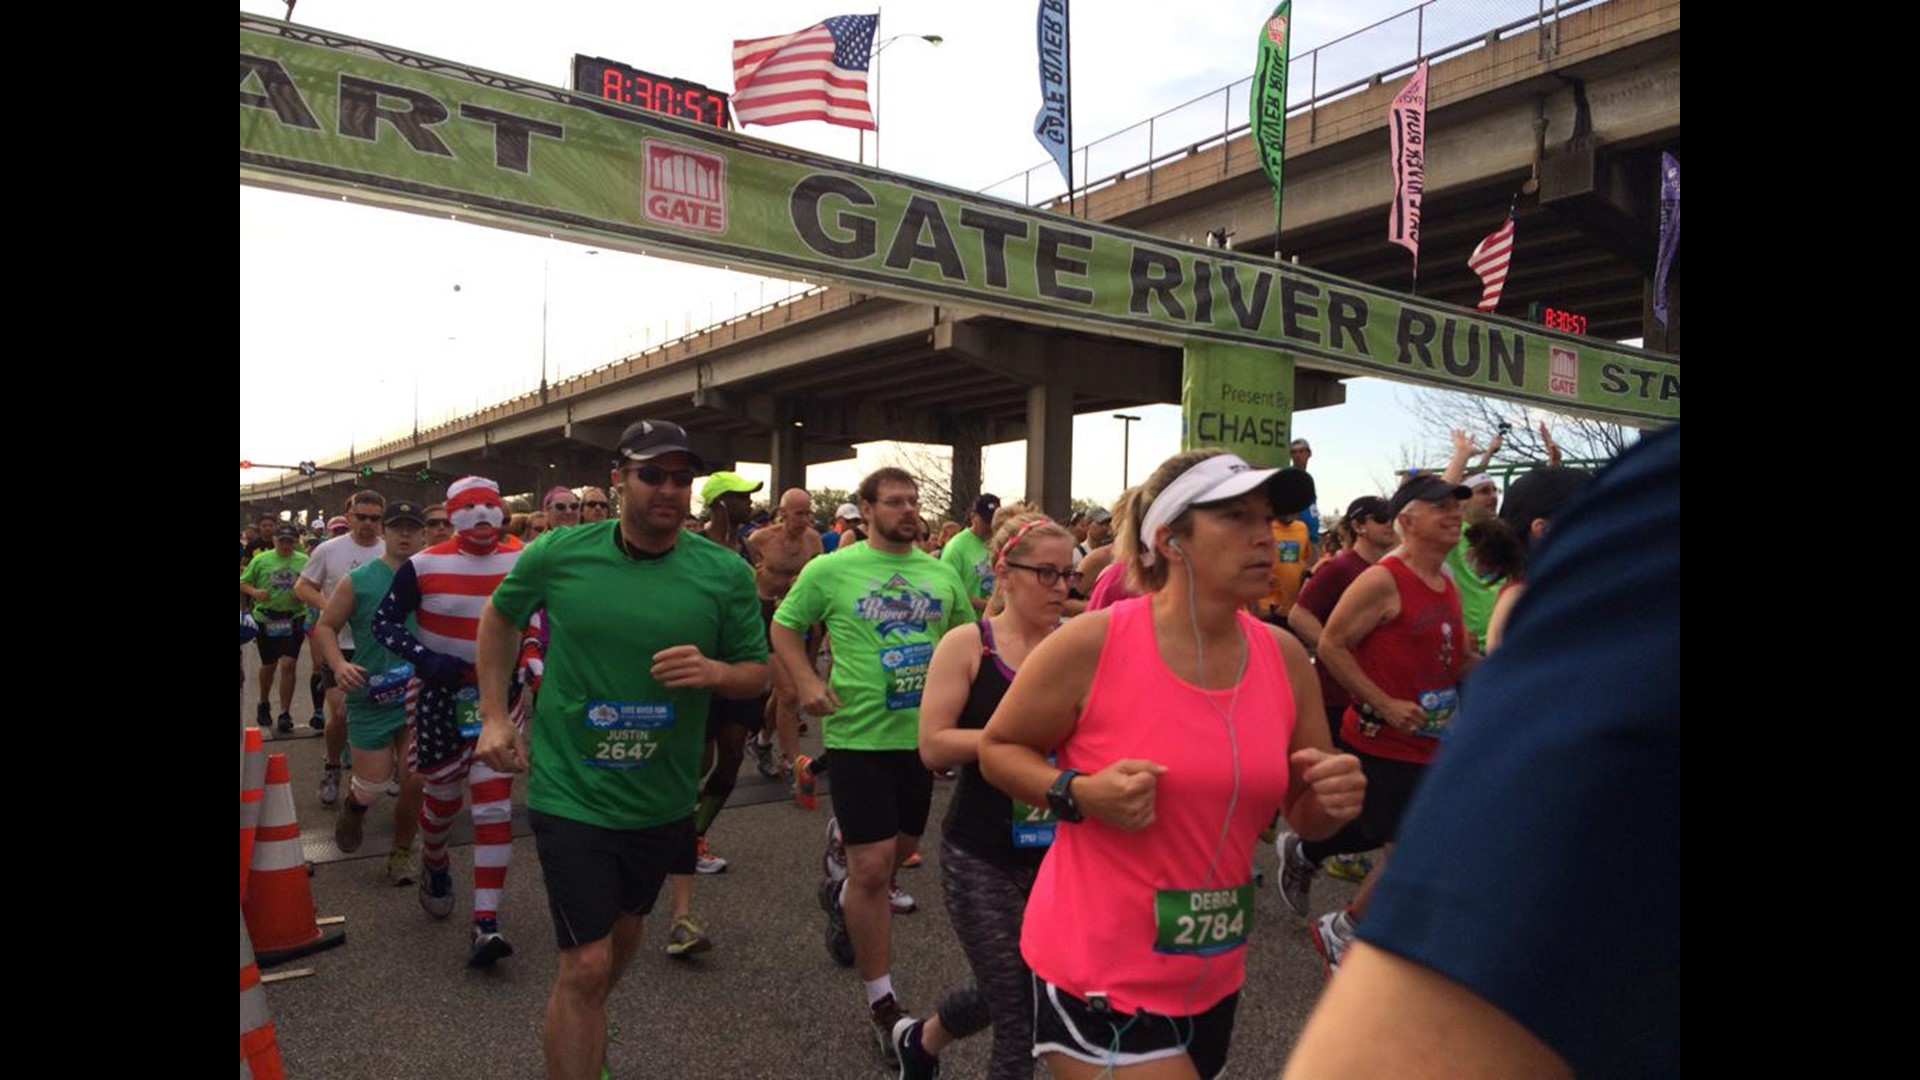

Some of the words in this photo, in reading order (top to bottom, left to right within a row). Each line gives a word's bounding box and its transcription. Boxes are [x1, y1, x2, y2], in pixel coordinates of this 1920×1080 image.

[240, 53, 564, 173] ART
[602, 67, 722, 129] 8:30:57
[648, 194, 722, 229] GATE
[789, 172, 1094, 305] GATE
[1131, 244, 1371, 356] RIVER
[1396, 306, 1527, 388] RUN
[1545, 307, 1587, 336] 8:30:57
[1550, 377, 1576, 395] GATE
[1600, 363, 1680, 401] STA
[1197, 411, 1286, 449] CHASE
[595, 742, 657, 760] 2647
[606, 729, 648, 740] JUSTIN
[1190, 889, 1238, 911] DEBRA
[1174, 909, 1244, 944] 2784
